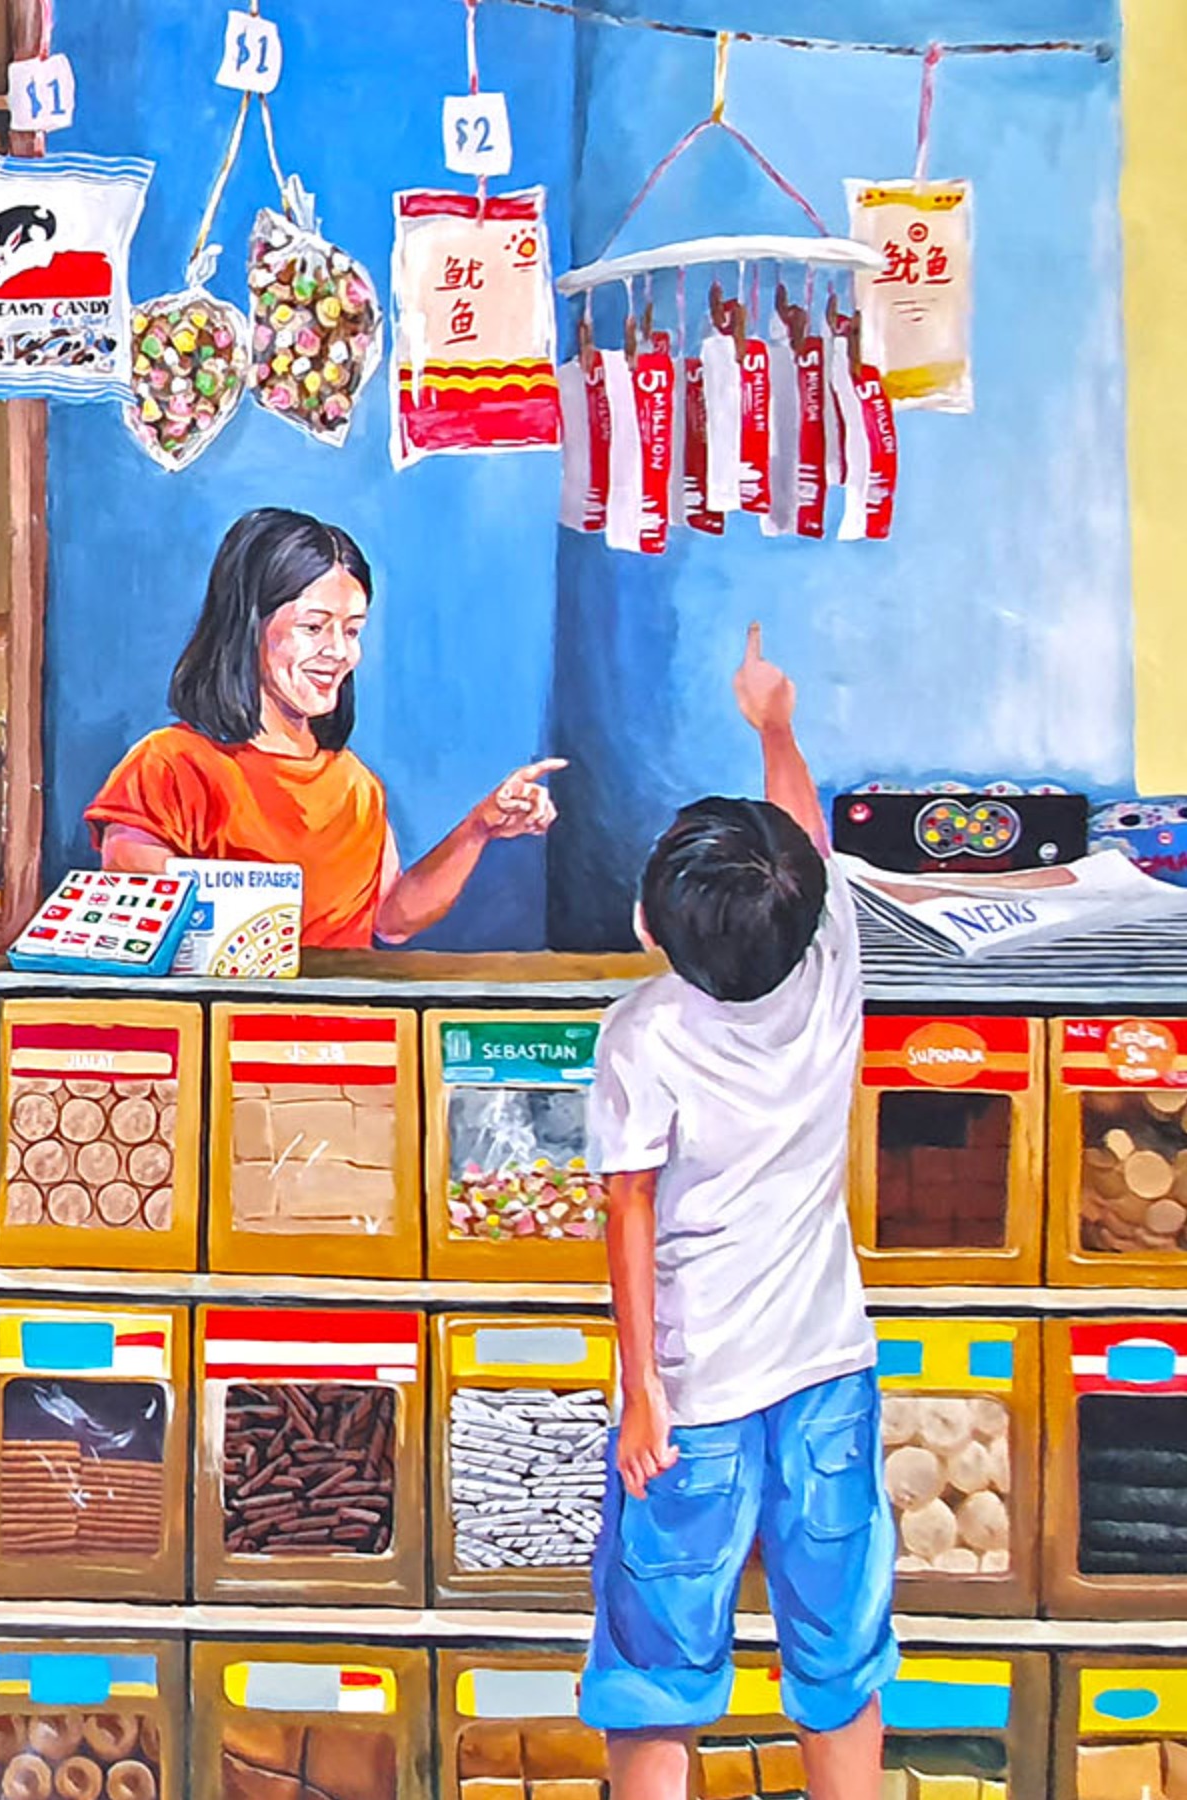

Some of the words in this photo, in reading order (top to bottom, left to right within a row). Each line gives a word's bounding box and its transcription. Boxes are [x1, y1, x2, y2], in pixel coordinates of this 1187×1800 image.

[235, 28, 269, 74] $1
[26, 76, 66, 119] $1
[455, 115, 494, 152] $2
[52, 300, 111, 318] CANDY
[434, 256, 484, 345] 鱿鱼
[744, 354, 765, 373] 5
[798, 351, 819, 368] 5
[637, 369, 667, 393] 5
[806, 371, 820, 423] MILLION
[753, 372, 766, 433] MILLION
[856, 380, 881, 400] 5
[872, 398, 898, 455] MILLION
[649, 393, 667, 471] MILLION
[205, 871, 244, 888] LION
[940, 900, 1037, 941] NEWS
[482, 1043, 577, 1060] SEBASTIAN
